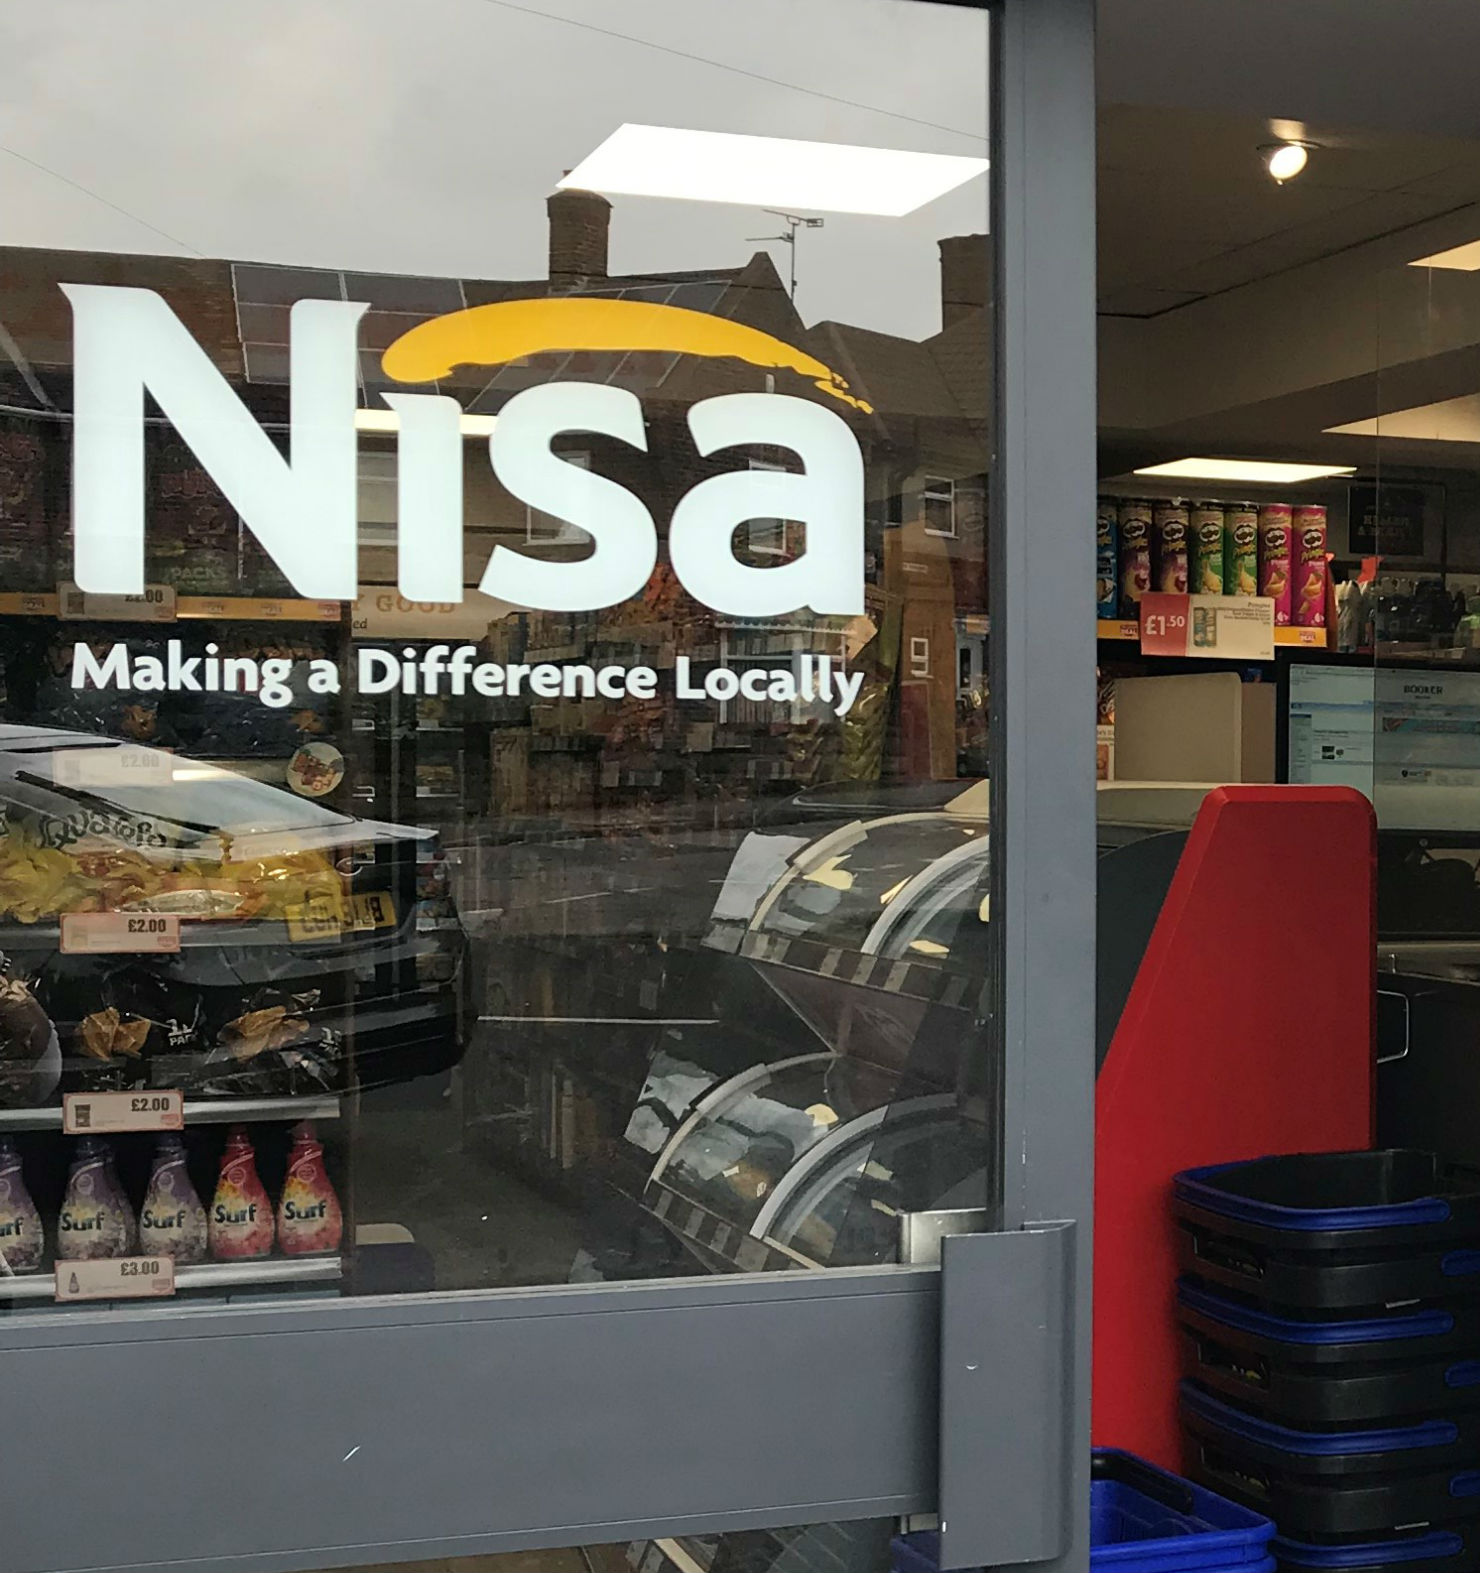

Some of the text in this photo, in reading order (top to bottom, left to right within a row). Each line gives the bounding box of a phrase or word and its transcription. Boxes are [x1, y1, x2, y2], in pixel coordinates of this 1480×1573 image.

[57, 282, 865, 616] Nisa
[71, 639, 865, 717] Making a Difference Locally
[128, 919, 167, 933] £2.00
[131, 1097, 170, 1112] £2.00
[143, 1210, 186, 1229] Surf
[214, 1203, 258, 1223] Surf
[285, 1200, 327, 1220] Surf
[0, 1216, 24, 1237] rf
[61, 1211, 105, 1231] Surf
[120, 1260, 159, 1276] £3.00
